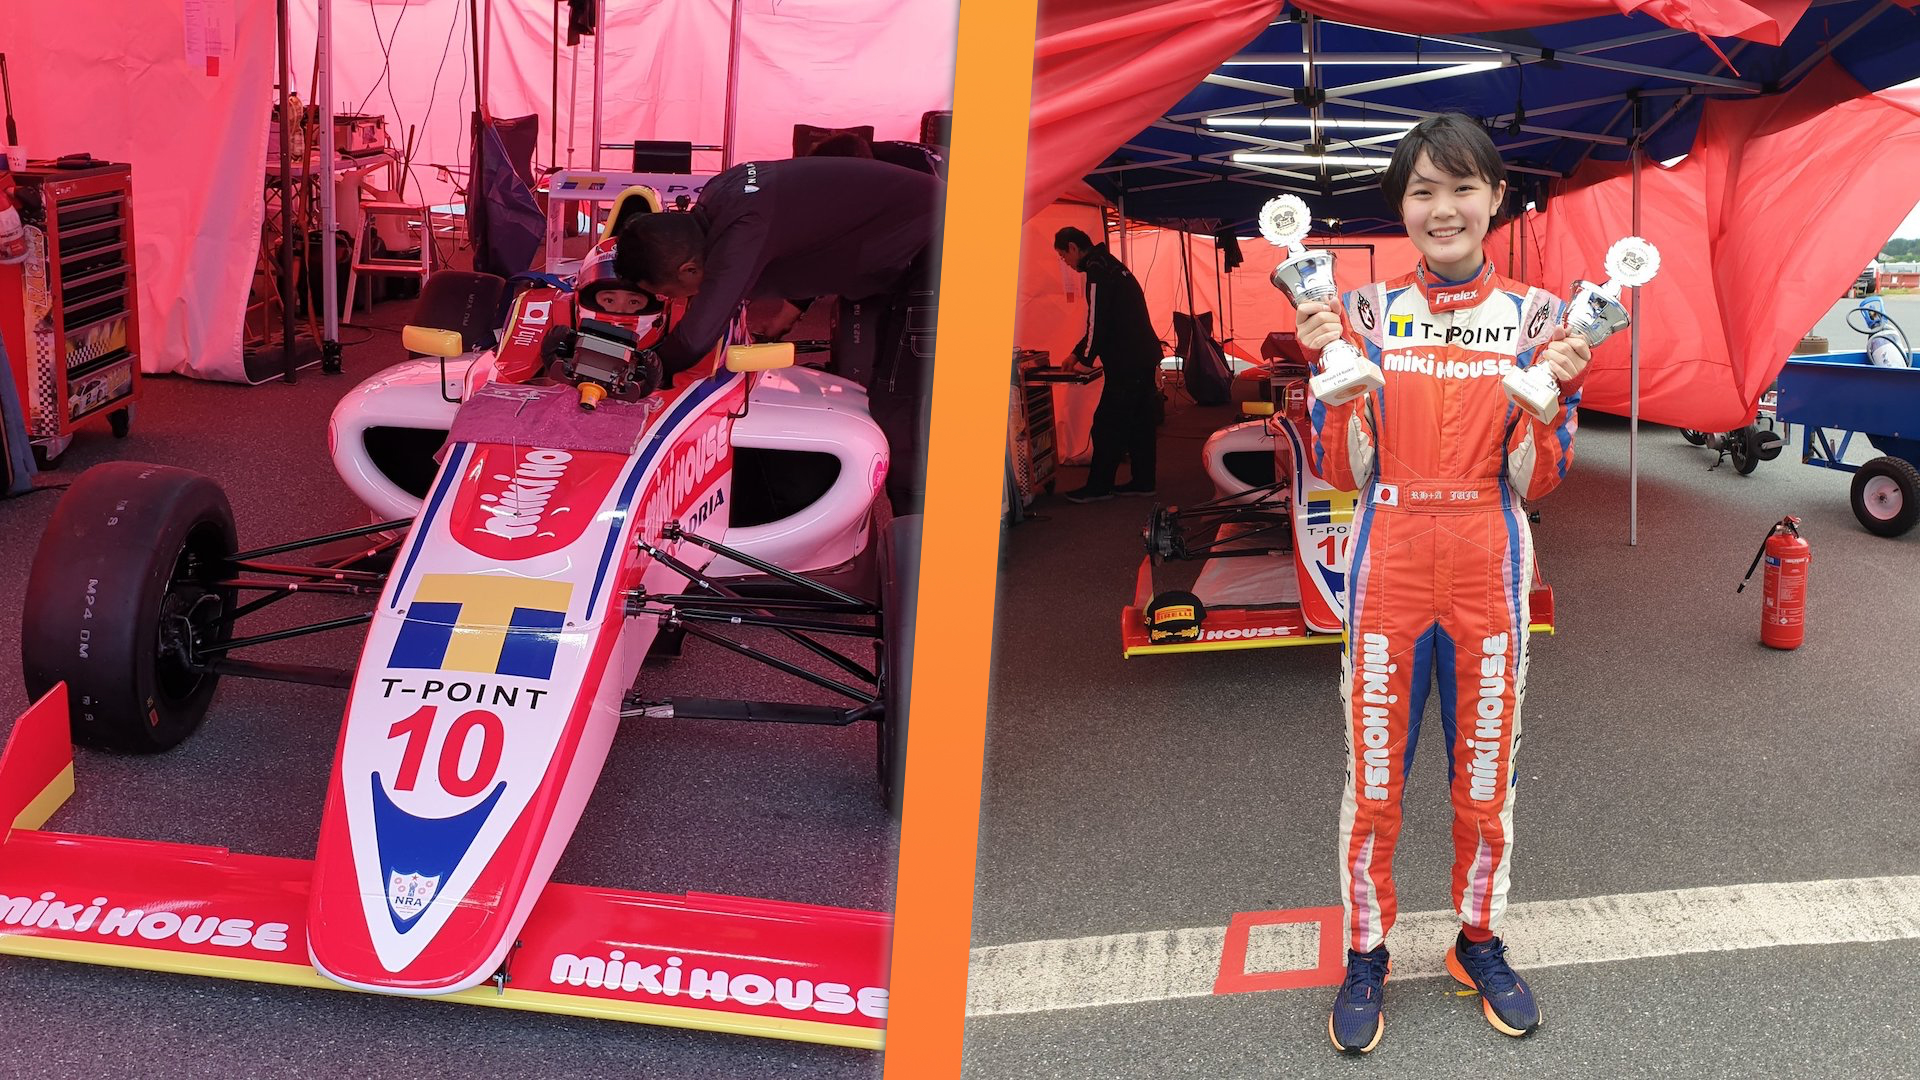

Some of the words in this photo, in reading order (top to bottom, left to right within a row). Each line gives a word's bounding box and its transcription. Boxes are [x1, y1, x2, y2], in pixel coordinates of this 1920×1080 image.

[1435, 290, 1477, 305] Firelex
[1421, 323, 1517, 344] T-POINT
[1384, 350, 1435, 375] miki
[1436, 359, 1512, 380] HOUSE
[674, 416, 728, 511] HOUSE
[480, 474, 559, 539] miki
[1307, 526, 1352, 536] T-PO
[83, 578, 99, 620] M24
[79, 629, 91, 659] DM
[1206, 626, 1292, 640] HOUSE
[1362, 632, 1398, 704] miki
[1474, 632, 1509, 739] HOUSE
[381, 678, 548, 710] T-POINT
[387, 705, 505, 798] 10
[1362, 706, 1391, 801] HOUSE
[1465, 738, 1501, 801] miki
[0, 892, 108, 932] miki
[98, 907, 289, 952] HOUSE
[394, 896, 422, 907] NRA
[550, 950, 683, 997] miki
[689, 969, 890, 1019] HOUSE
